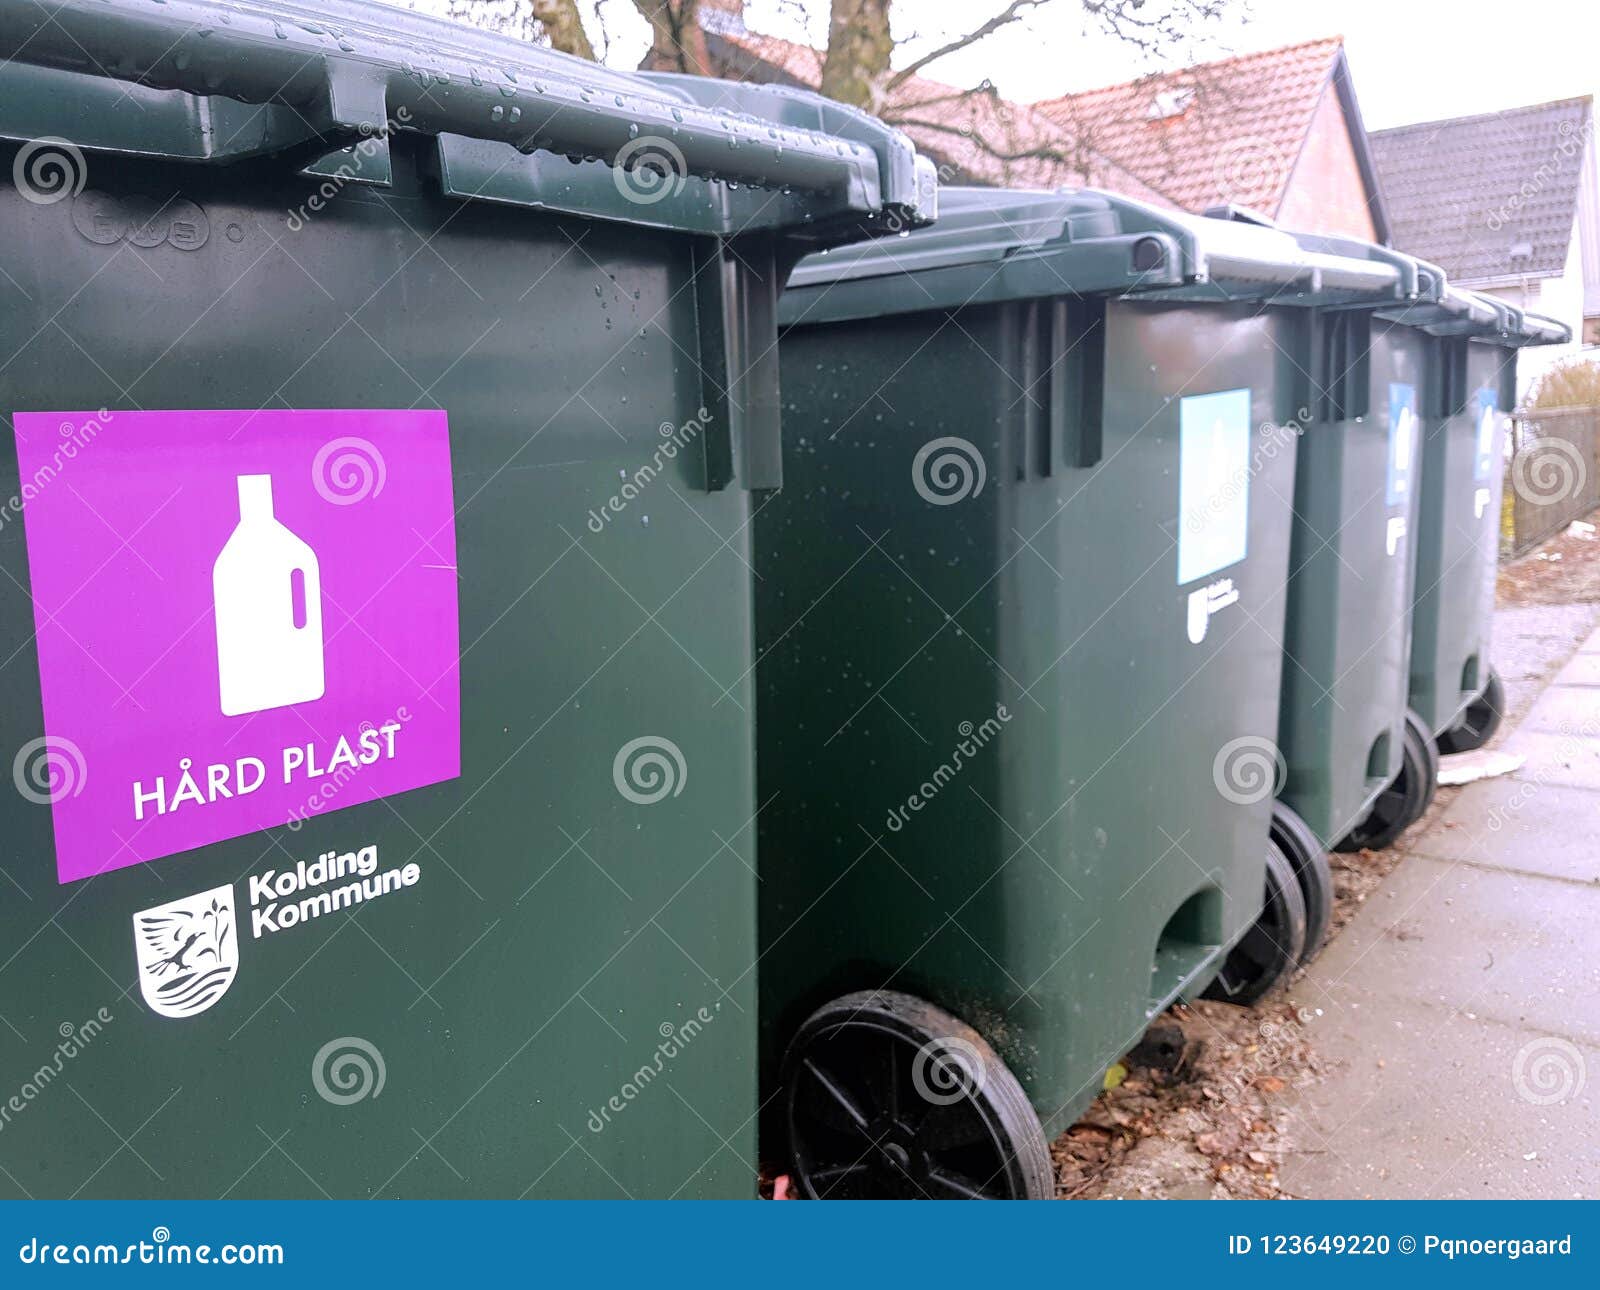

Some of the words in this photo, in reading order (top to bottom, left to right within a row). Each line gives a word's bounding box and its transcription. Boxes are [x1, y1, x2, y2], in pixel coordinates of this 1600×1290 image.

[132, 757, 267, 821] HÅRD
[282, 723, 402, 784] PLAST
[249, 844, 379, 907] Kolding
[251, 862, 421, 940] Kommune
